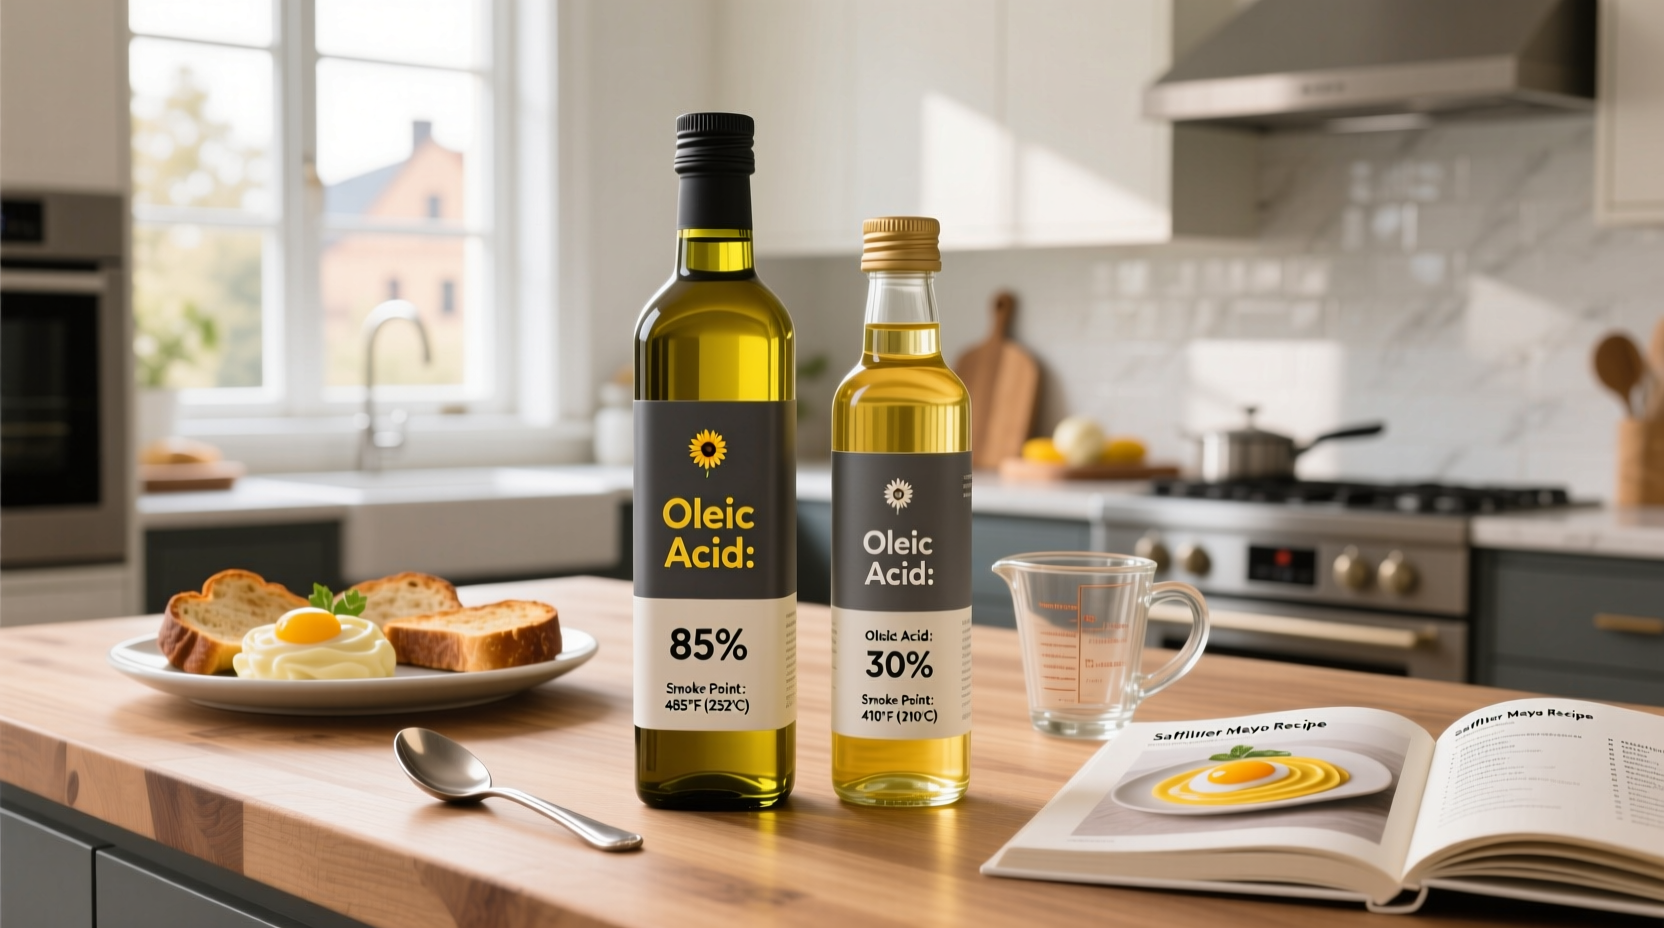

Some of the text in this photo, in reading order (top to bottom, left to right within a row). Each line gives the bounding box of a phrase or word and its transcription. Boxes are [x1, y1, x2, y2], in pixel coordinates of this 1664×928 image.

[662, 497, 755, 529] Oleic
[664, 536, 755, 569] Acid:
[863, 530, 933, 555] Oleic
[864, 561, 934, 586] Acid:
[670, 627, 748, 661] 85%
[900, 629, 933, 642] Acid:
[866, 650, 933, 679] 30%
[666, 681, 746, 695] Smoke Point:
[861, 693, 899, 706] Smoke
[1226, 725, 1270, 736] Mayo
[1274, 719, 1327, 732] Recipe
